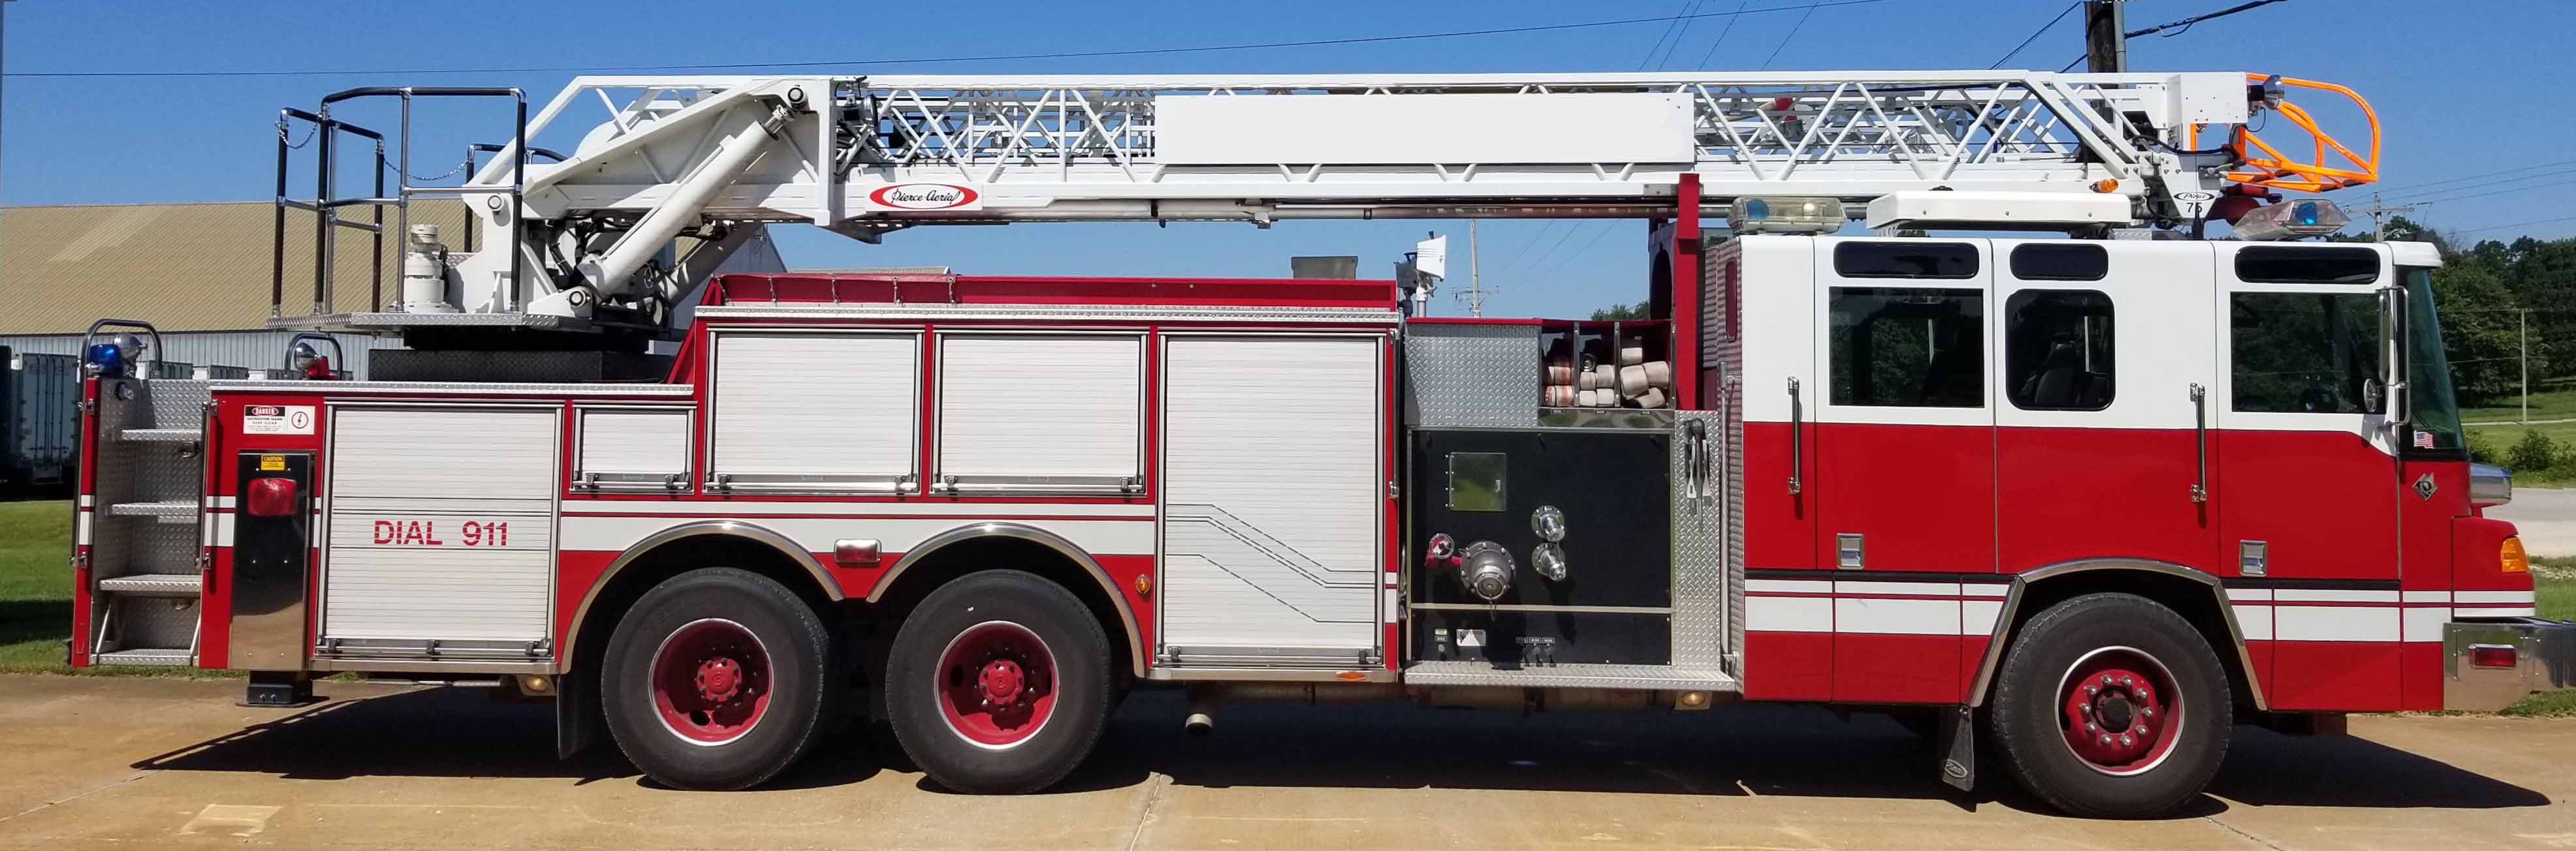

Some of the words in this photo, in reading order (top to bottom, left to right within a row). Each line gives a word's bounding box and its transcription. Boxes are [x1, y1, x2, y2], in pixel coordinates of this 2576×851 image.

[891, 187, 925, 204] Pierce
[925, 189, 961, 204] Aerial
[2186, 202, 2202, 213] 75
[374, 520, 443, 546] DIAL
[461, 520, 508, 547] 911
